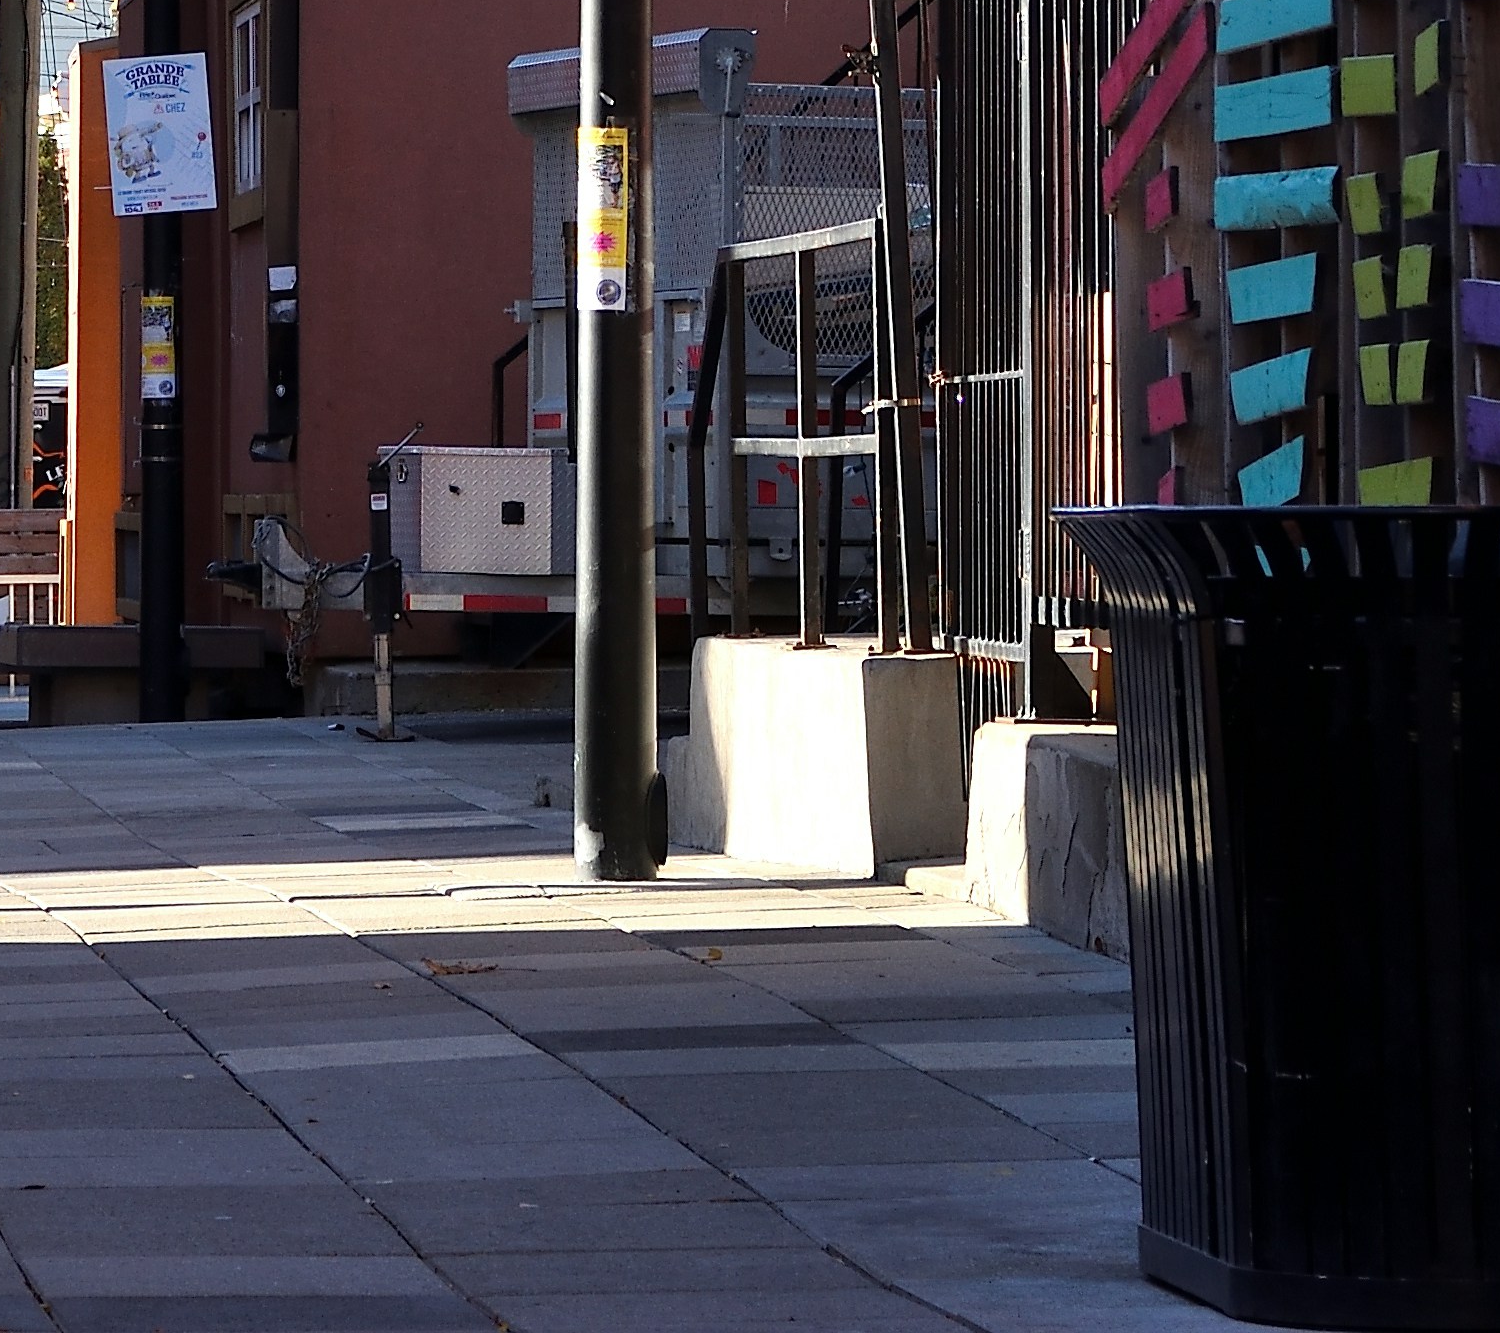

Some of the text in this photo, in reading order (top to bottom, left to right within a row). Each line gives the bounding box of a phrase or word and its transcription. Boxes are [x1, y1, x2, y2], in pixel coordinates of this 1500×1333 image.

[126, 63, 185, 81] GRANDE
[130, 72, 180, 91] TABLÉE
[165, 102, 186, 113] CHEZ
